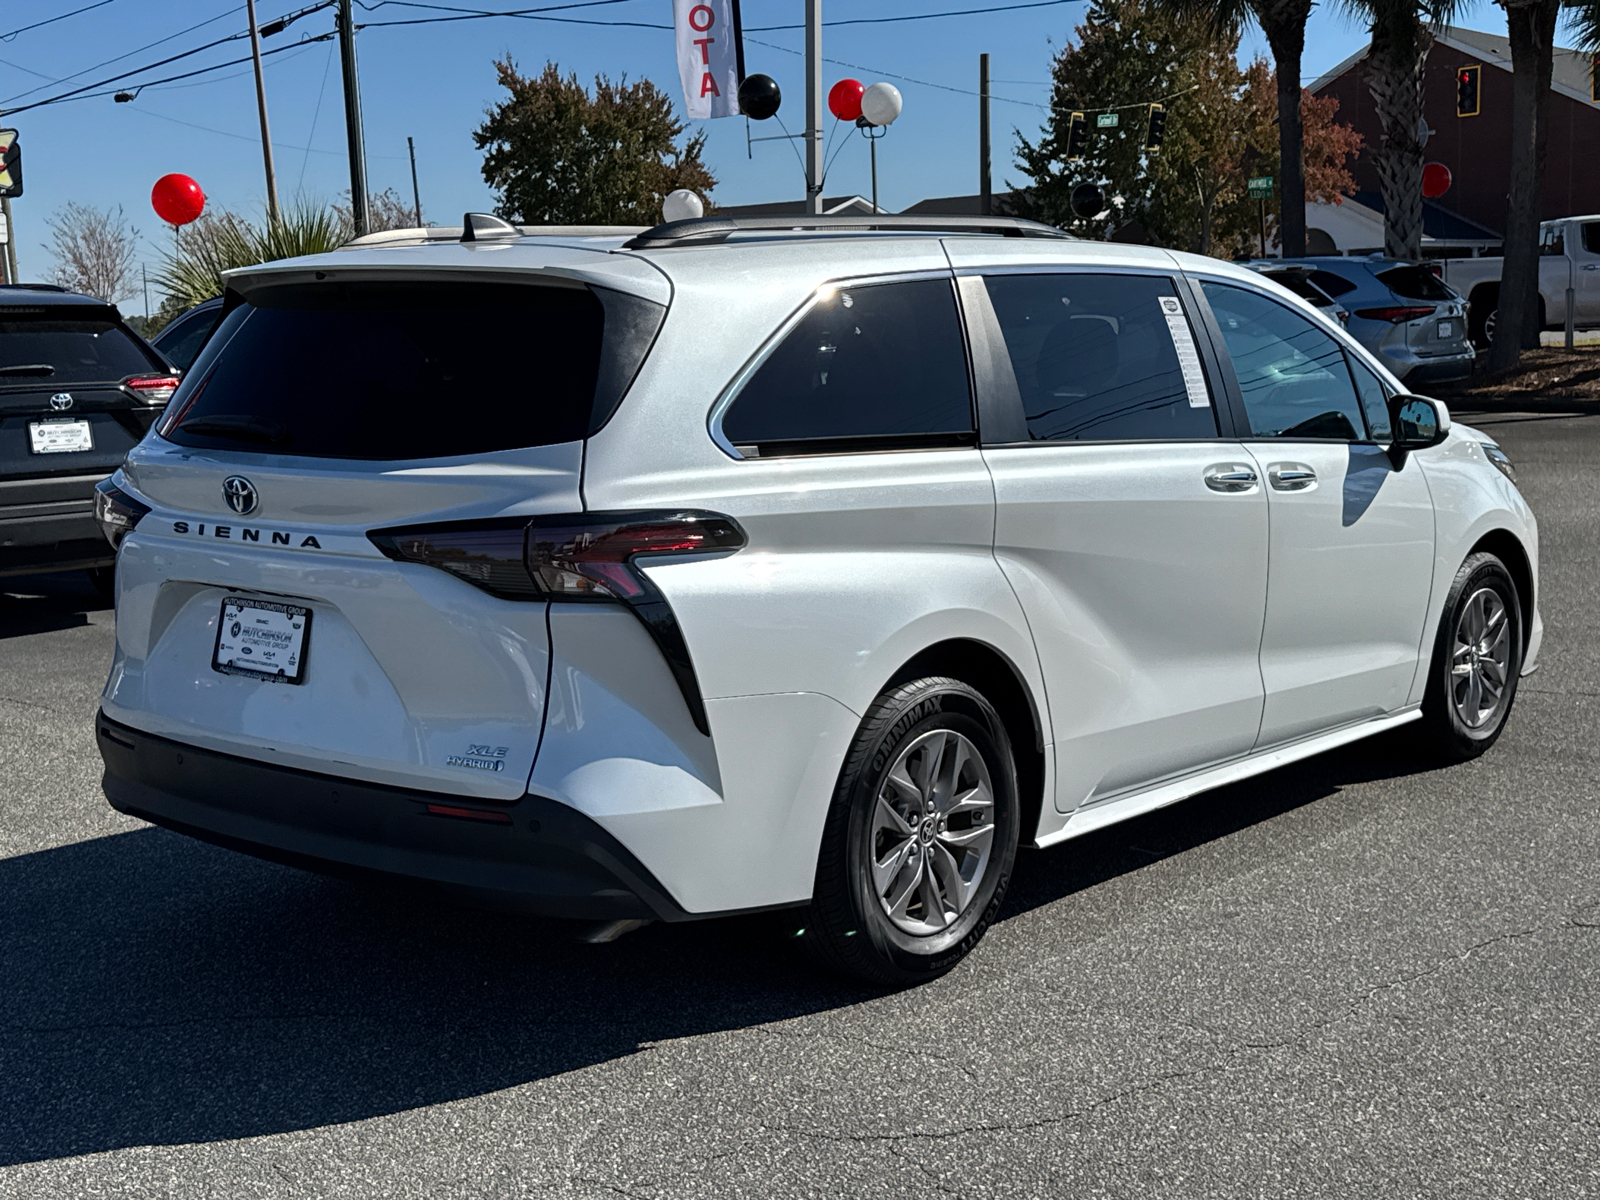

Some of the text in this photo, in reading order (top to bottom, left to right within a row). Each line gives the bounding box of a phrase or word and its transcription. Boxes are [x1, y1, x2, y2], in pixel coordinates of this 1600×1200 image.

[173, 521, 322, 549] SIENNA
[224, 598, 307, 616] HUTCHINSON AUTOMOTIVE GROUP
[241, 626, 293, 644] HUTCHINSON
[241, 637, 271, 648] AUTOMOTIVE
[271, 641, 289, 650] GROUP
[873, 695, 943, 772] OMNIMAX
[466, 744, 509, 758] XLE
[446, 755, 494, 771] HYBRID
